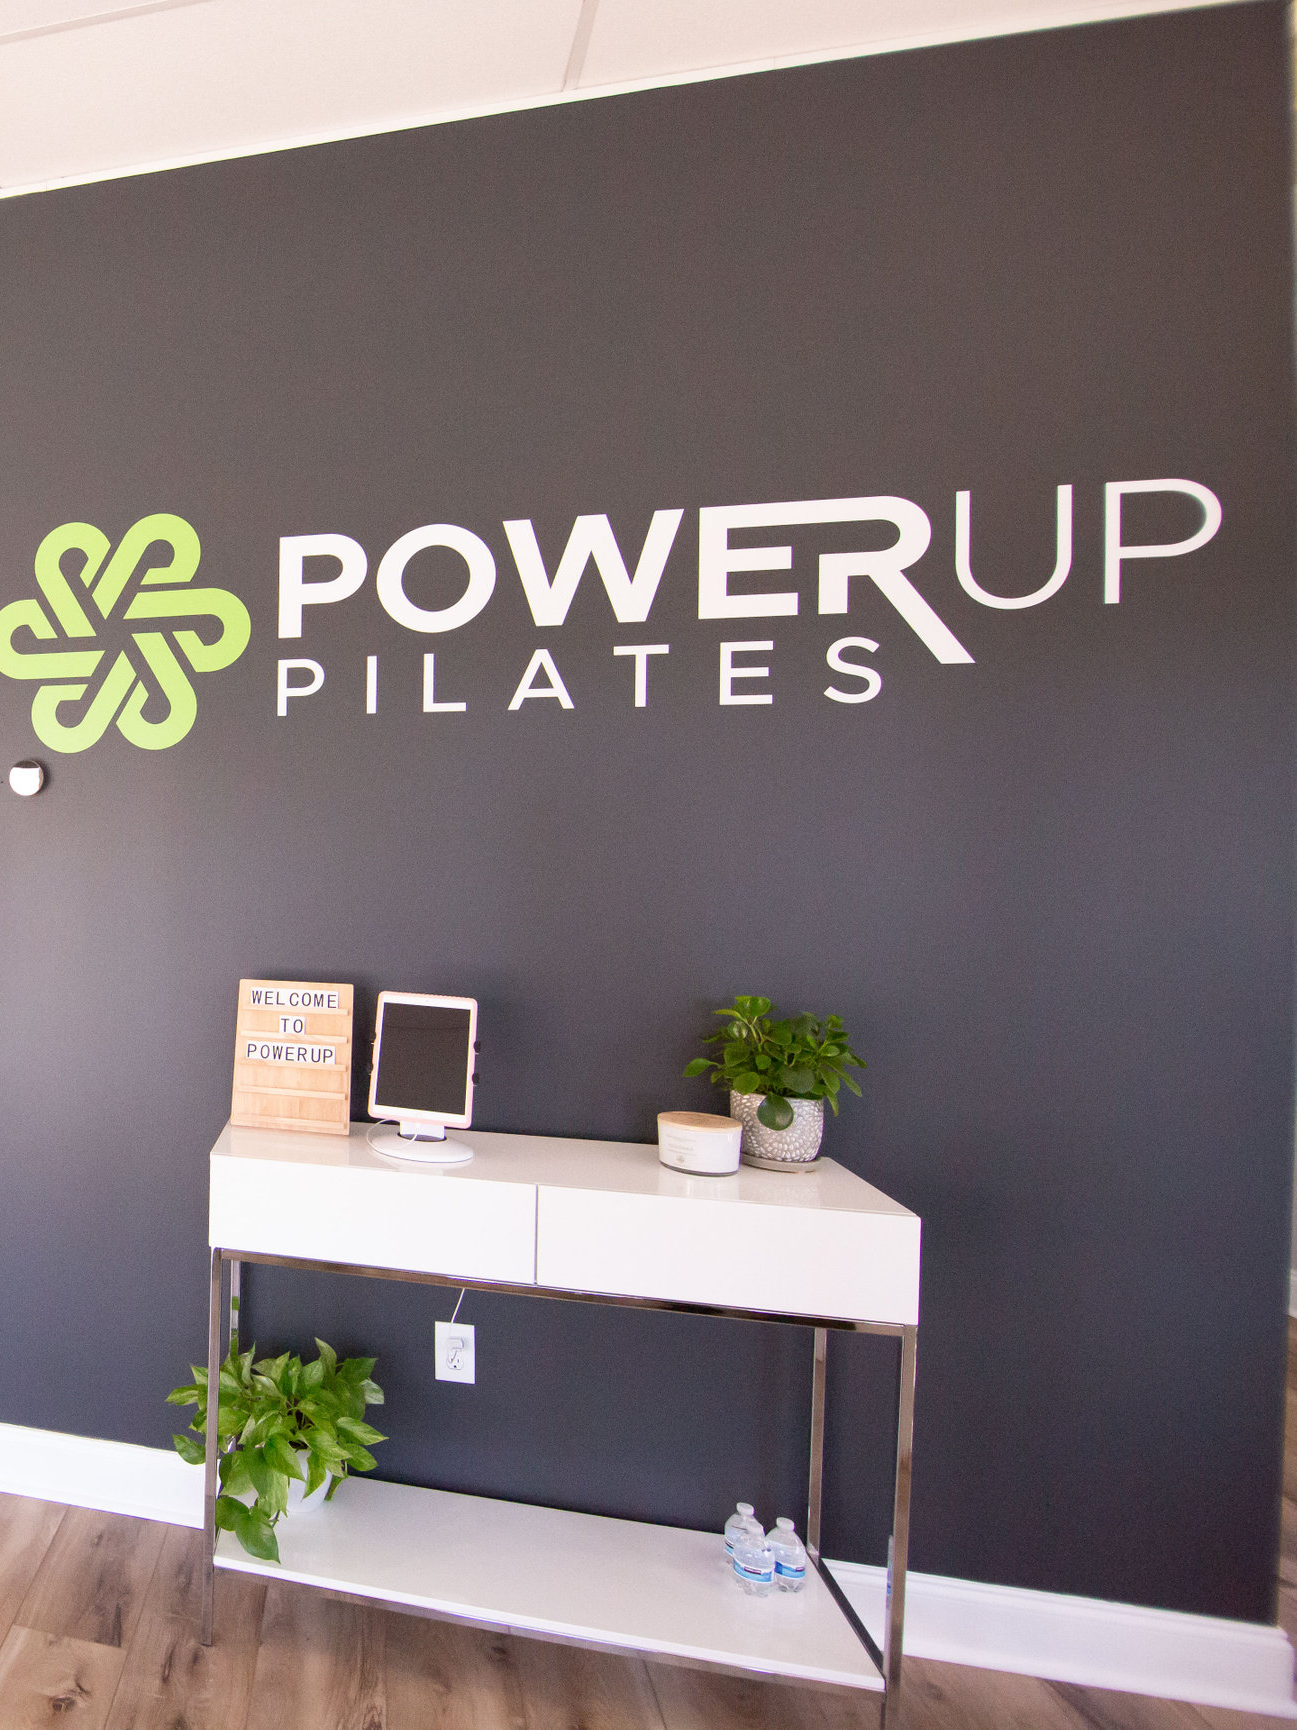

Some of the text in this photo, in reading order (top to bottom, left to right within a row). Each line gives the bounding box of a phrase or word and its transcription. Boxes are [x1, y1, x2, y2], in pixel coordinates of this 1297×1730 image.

[276, 636, 882, 717] PILATES
[251, 990, 337, 1009] WELCOME
[280, 1018, 304, 1033] TO
[246, 1043, 333, 1064] POWERUP
